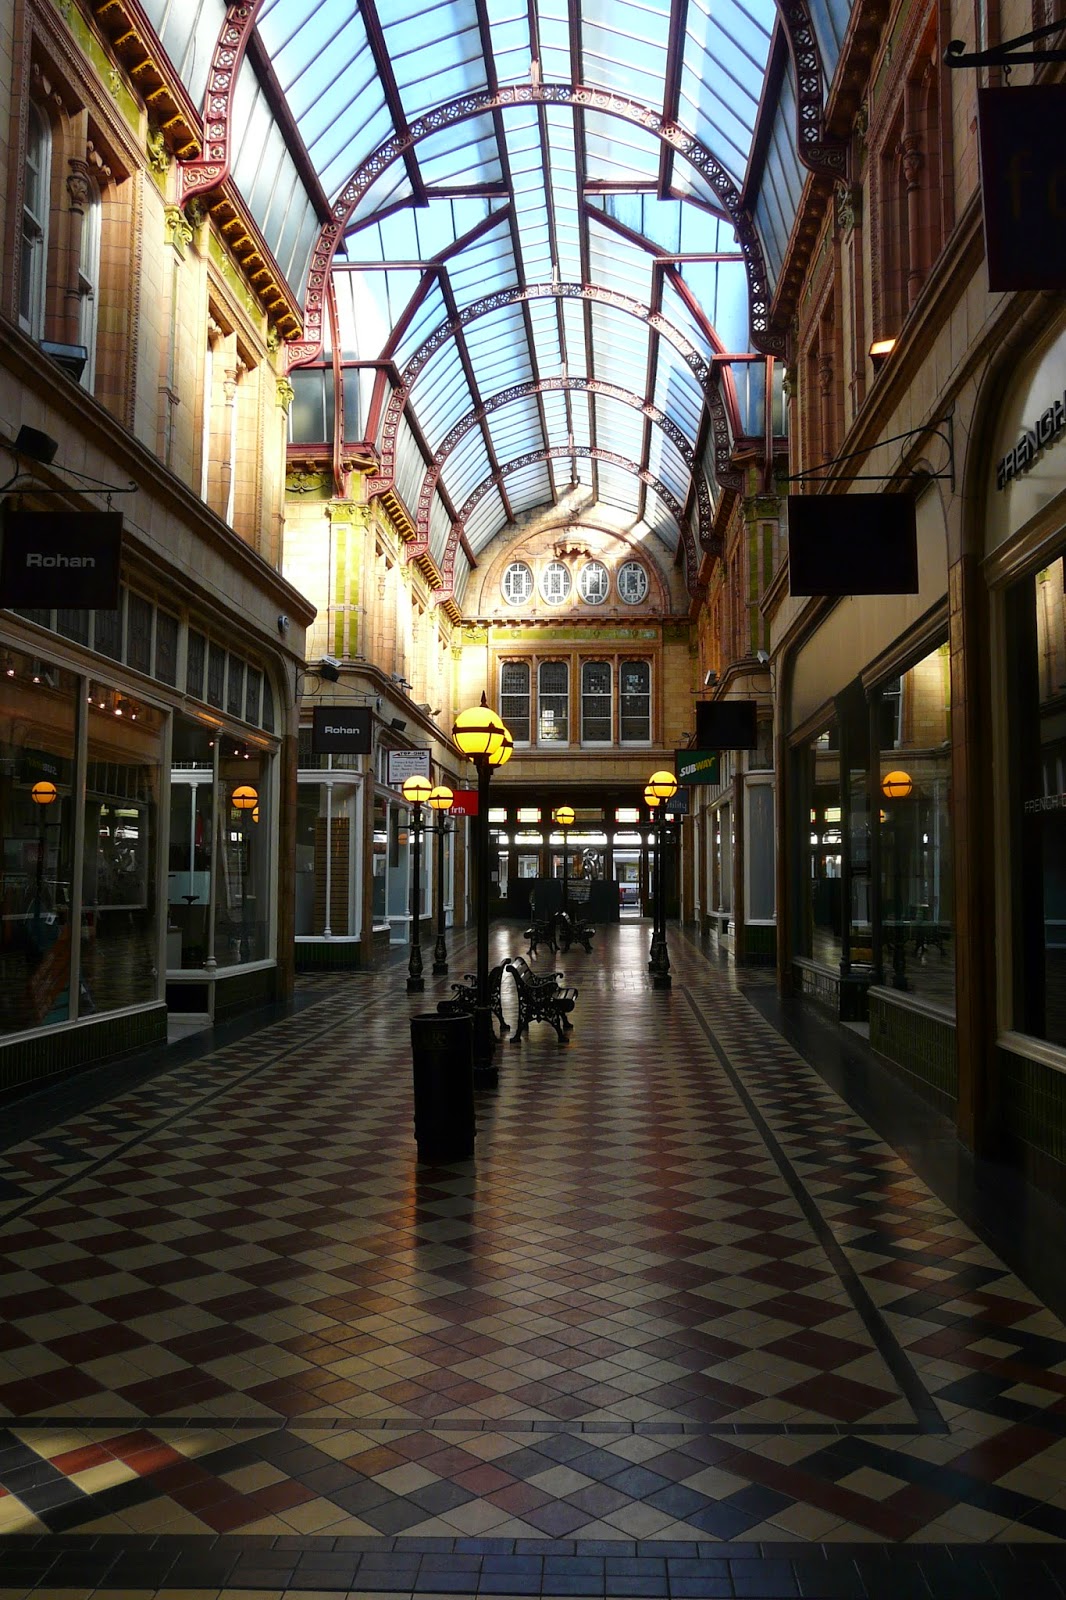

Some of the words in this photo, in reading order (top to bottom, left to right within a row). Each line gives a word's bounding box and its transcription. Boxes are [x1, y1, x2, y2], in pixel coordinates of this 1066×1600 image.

[26, 552, 95, 568] Rohan
[324, 725, 360, 735] Rohan
[679, 756, 716, 777] SUBWAY
[1024, 794, 1059, 813] FRENCH
